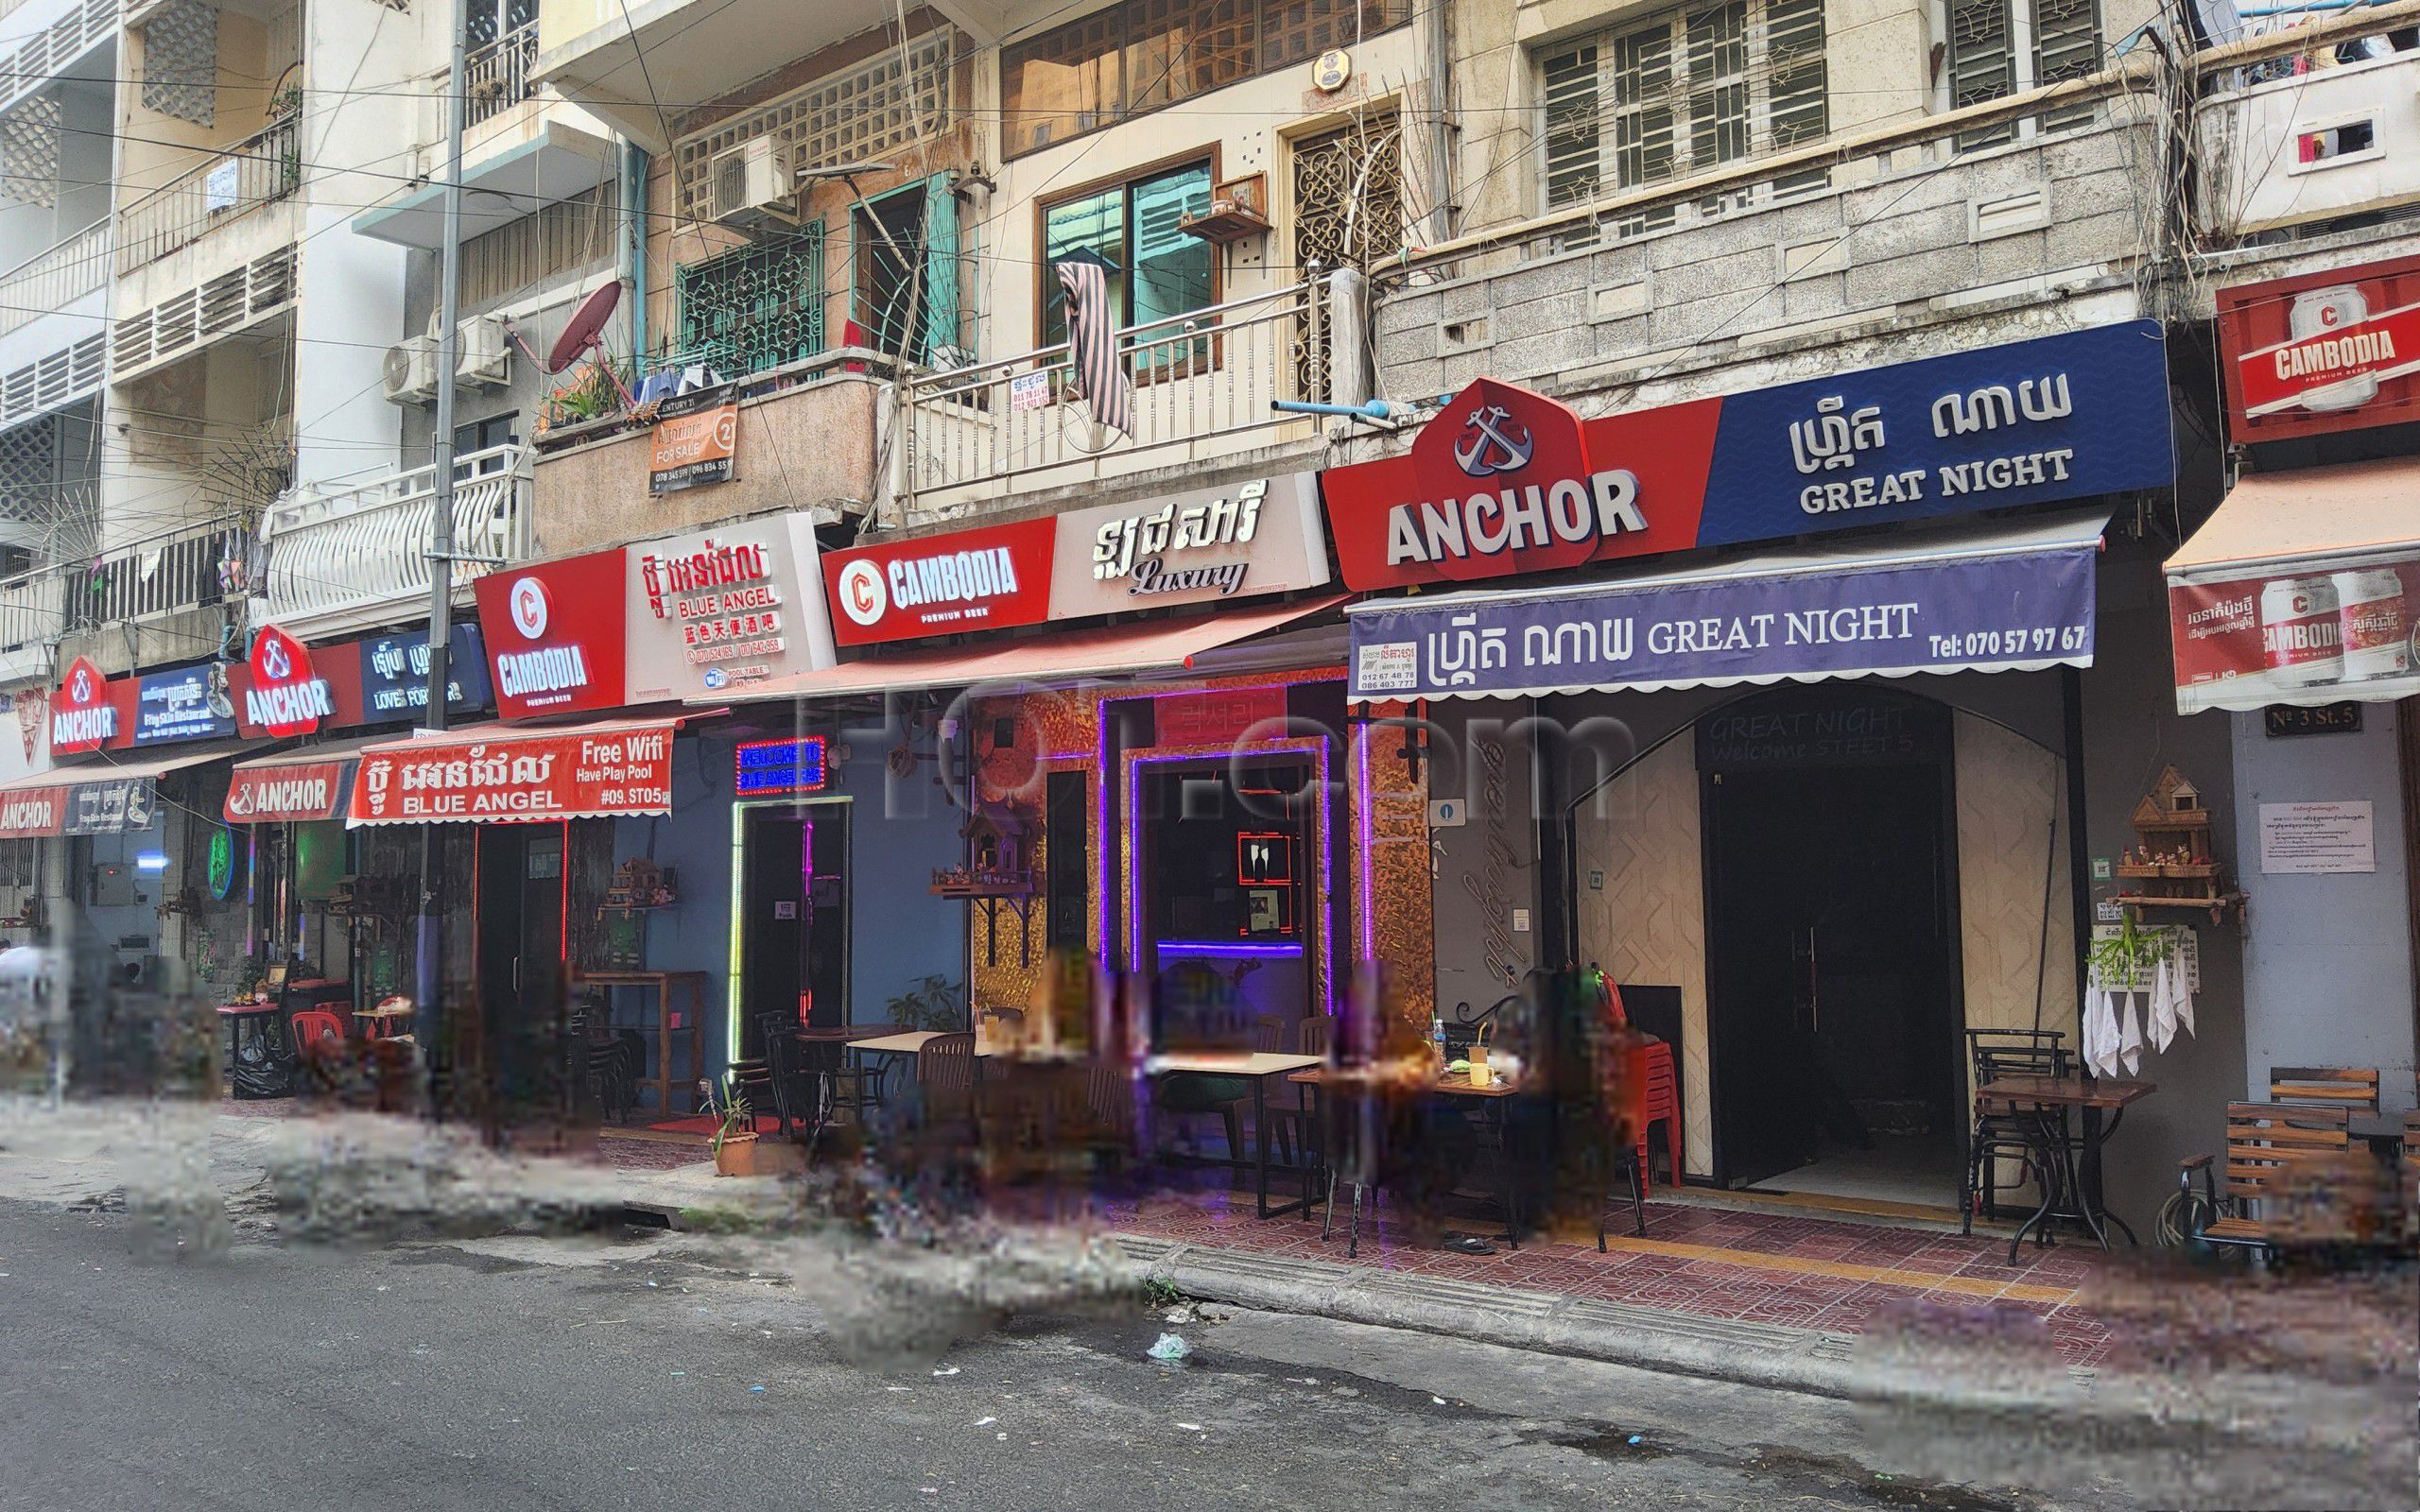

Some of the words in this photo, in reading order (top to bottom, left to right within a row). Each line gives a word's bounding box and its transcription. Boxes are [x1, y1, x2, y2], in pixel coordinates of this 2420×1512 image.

[2275, 331, 2396, 381] CAMBODIA
[2306, 372, 2343, 383] PREMIUM
[2345, 367, 2368, 376] BEER
[659, 401, 687, 413] ENTURY
[688, 398, 695, 408] 21
[720, 422, 735, 441] 21
[656, 449, 675, 464] FOR
[675, 442, 700, 460] SALE
[655, 472, 667, 483] 078
[1800, 470, 1927, 515] GREAT
[1940, 449, 2075, 497] NIGHT
[1387, 469, 1648, 566] ANCHOR
[888, 546, 1019, 610] CAMBODIA
[1128, 558, 1250, 597] Luxury
[678, 596, 717, 619] BLUE
[723, 587, 776, 612] ANGEL
[920, 610, 961, 624] PREMIUM
[964, 607, 990, 619] BEER
[1648, 614, 1773, 655] GREAT
[1784, 603, 1919, 646] NIGHT
[1929, 634, 1962, 658] Tel:
[1965, 631, 2000, 656] 070
[2004, 629, 2028, 654] 57
[2032, 627, 2056, 652] 97
[2062, 626, 2085, 650] 67
[497, 645, 588, 698] CAMBODIA
[745, 666, 765, 676] TABLE
[246, 679, 331, 727] ANCHOR
[373, 690, 403, 710] LOVE
[526, 695, 554, 708] PREMIUM
[555, 693, 572, 704] BEER
[54, 706, 113, 745] ANCHOR
[1709, 713, 1808, 741] GREAT
[1814, 708, 1906, 734] NIGHT
[2300, 709, 2310, 727] 3
[2316, 708, 2340, 726] St.
[2343, 707, 2354, 724] 5
[582, 740, 622, 765] Free
[627, 735, 664, 762] Wifi
[740, 744, 801, 767] WELCOME
[804, 742, 821, 762] TO
[576, 766, 601, 782] Have
[602, 765, 626, 783] Play
[628, 764, 652, 781] Pool
[256, 779, 327, 813] ANCHOR
[404, 793, 466, 815] BLUE
[472, 790, 562, 813] ANGEL
[600, 788, 627, 805] #09.
[629, 787, 662, 804] ST05
[0, 800, 52, 830] ANCHOR
